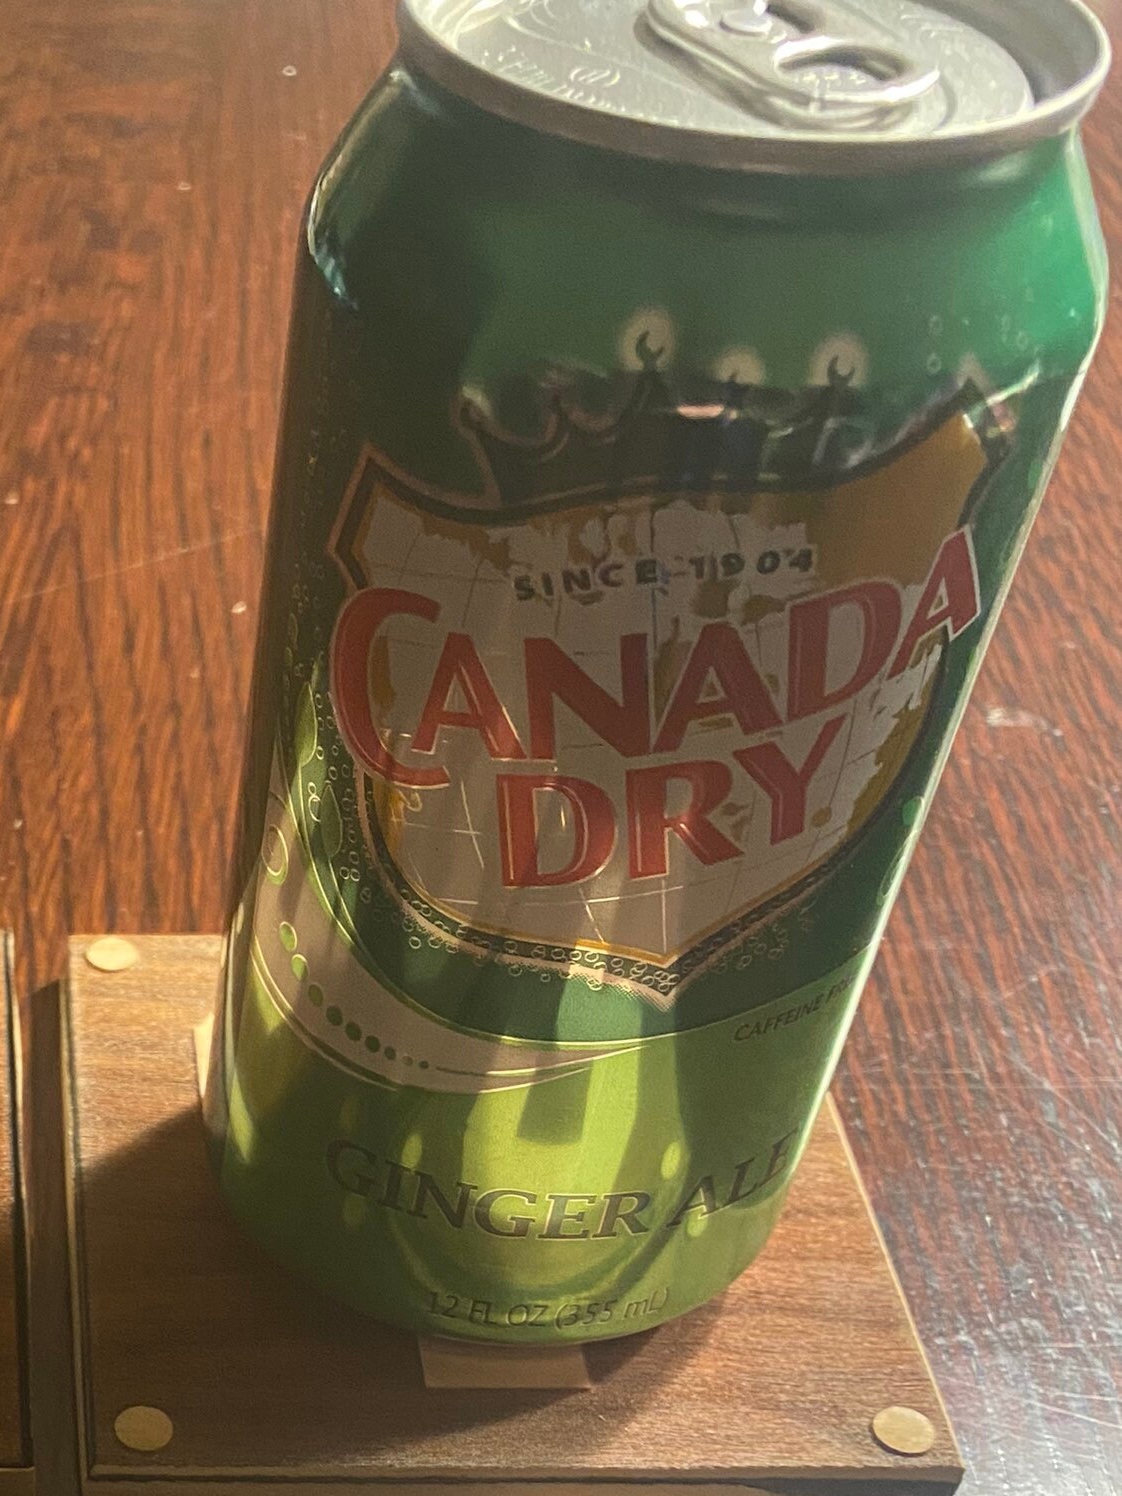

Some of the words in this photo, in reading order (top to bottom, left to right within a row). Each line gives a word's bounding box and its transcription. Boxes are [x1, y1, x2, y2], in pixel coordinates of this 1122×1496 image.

[513, 557, 660, 601] SINCE
[689, 547, 814, 581] 1904
[329, 523, 980, 790] CANADA
[495, 713, 847, 890] DRY
[732, 993, 824, 1042] CAFFEINE
[324, 1137, 652, 1242] GINGER
[666, 1127, 800, 1229] ALE
[428, 1291, 460, 1318] 12
[468, 1300, 500, 1327] FL
[504, 1303, 550, 1328] OZ
[552, 1299, 614, 1333] (355
[621, 1286, 670, 1319] mL)
